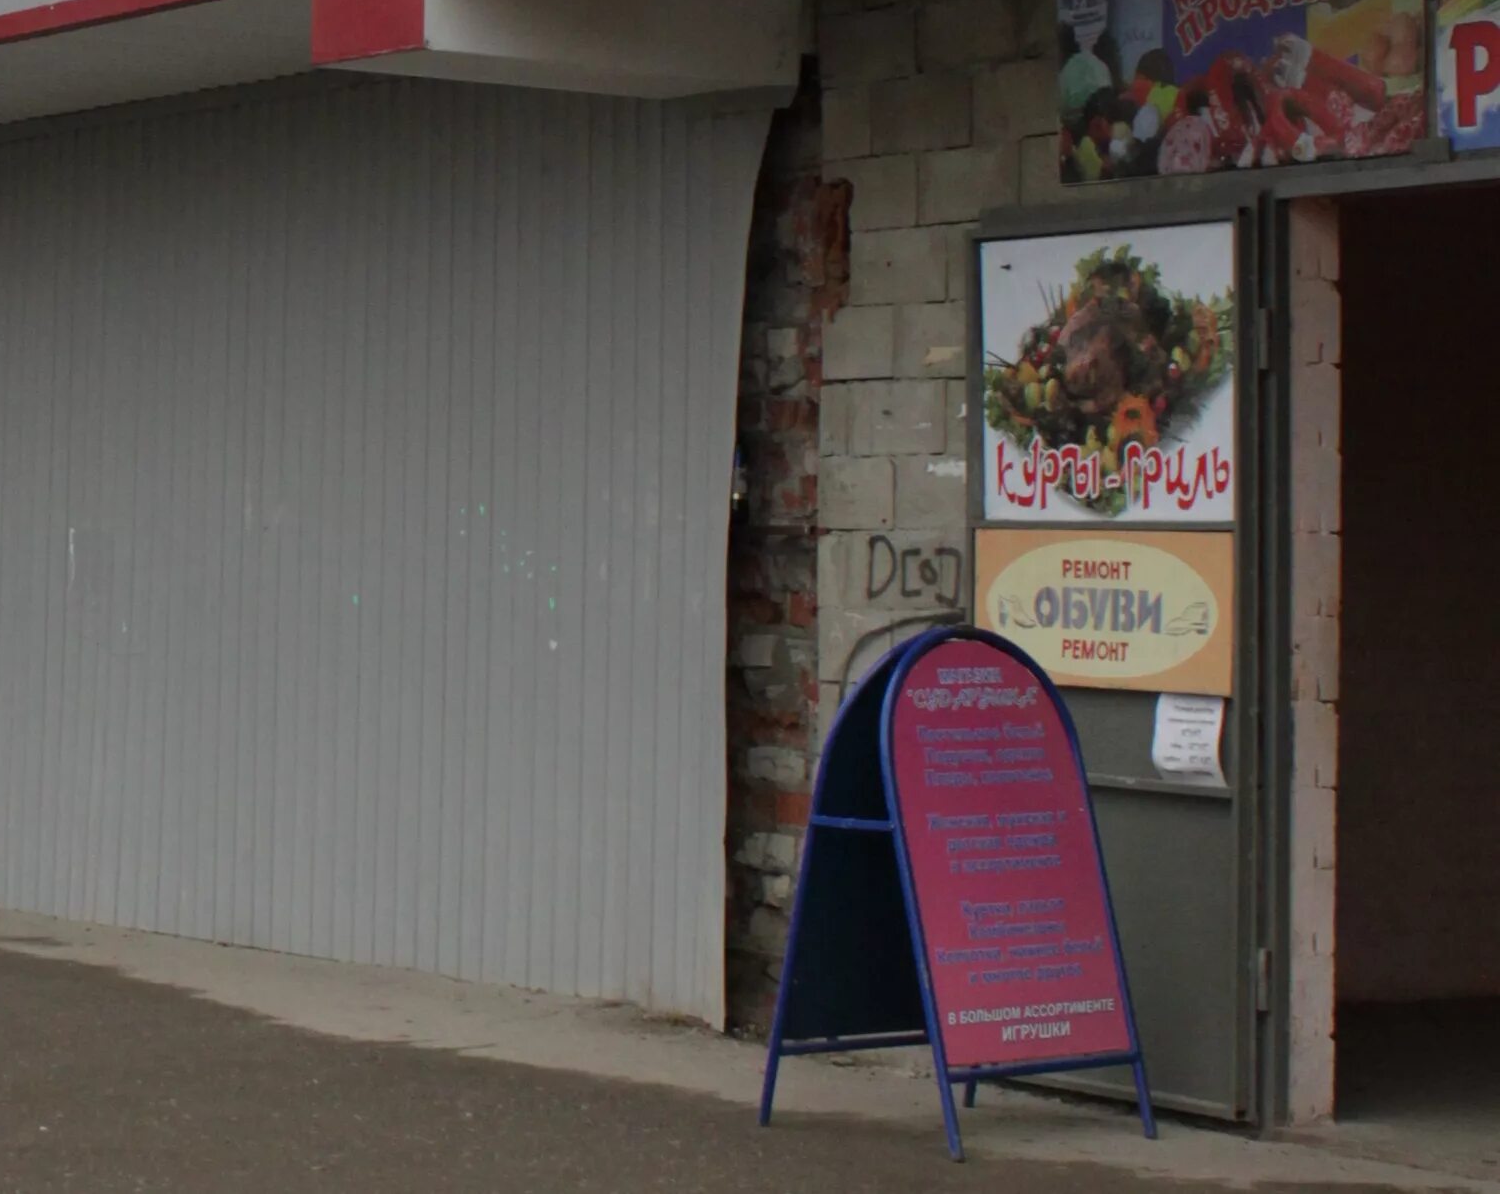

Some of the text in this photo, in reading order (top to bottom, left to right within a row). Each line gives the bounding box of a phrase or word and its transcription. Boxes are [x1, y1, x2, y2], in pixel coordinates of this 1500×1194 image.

[1061, 558, 1133, 581] РЕМОНТ
[1033, 585, 1163, 635] ОБУВИ
[1061, 639, 1130, 662] РЕМОНТ
[947, 998, 1116, 1025] В БОЛЬШОМ АССОРТИМЕНТЕ
[1001, 1021, 1071, 1043] ИГРУШКИ
